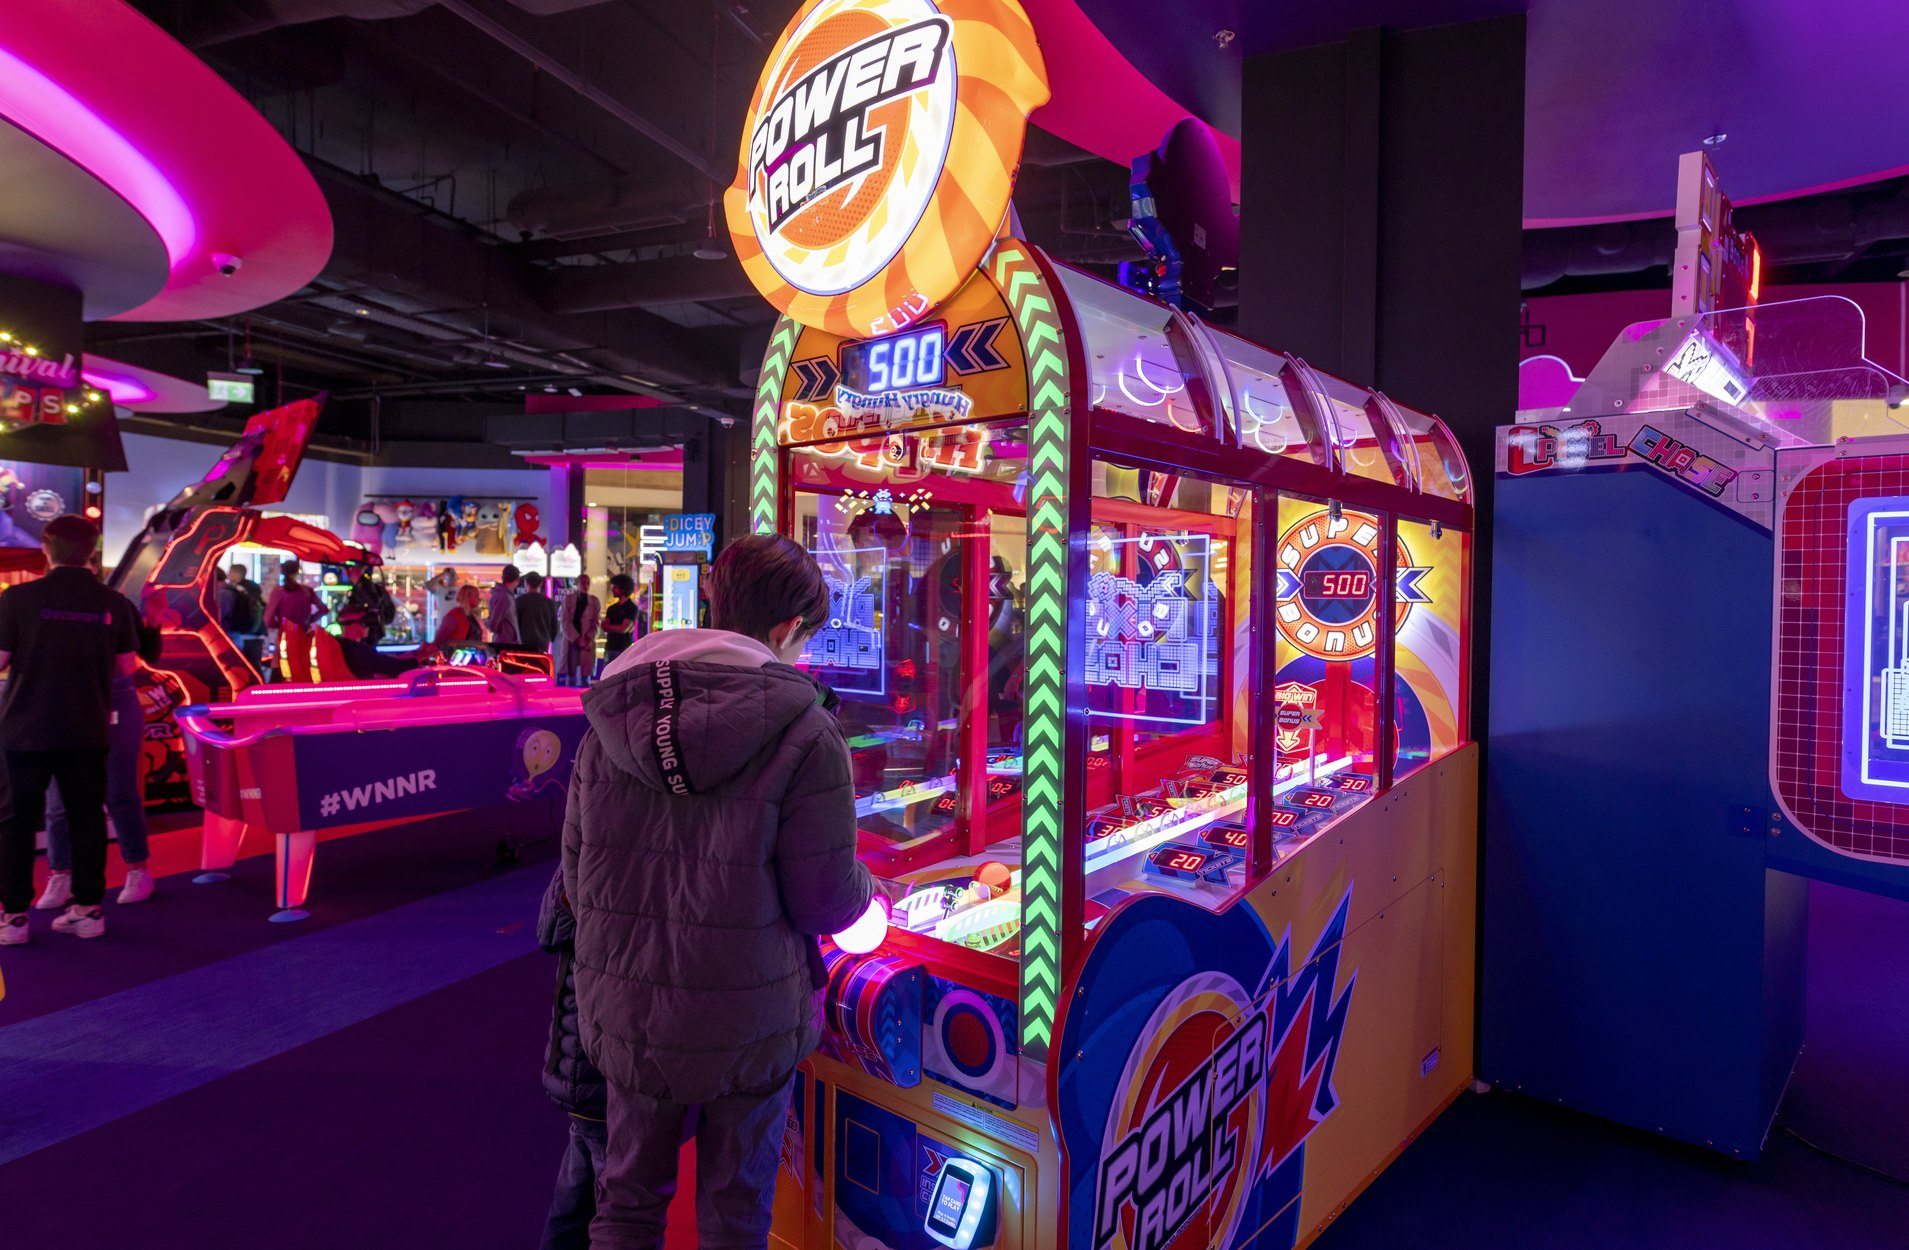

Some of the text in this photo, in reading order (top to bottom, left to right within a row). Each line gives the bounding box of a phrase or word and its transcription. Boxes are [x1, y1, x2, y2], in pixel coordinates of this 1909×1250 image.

[750, 26, 943, 193] POWER
[771, 116, 878, 223] ROLL
[868, 332, 941, 392] 500
[1631, 426, 1735, 495] CHASE
[669, 517, 712, 531] DICEY
[1281, 517, 1377, 570] SUPE
[1323, 574, 1367, 596] 500
[1277, 602, 1377, 653] BONU
[655, 658, 688, 795] SUPPLY YOUNG SU
[319, 768, 438, 818] #WNNR
[1305, 794, 1332, 807] 20
[1341, 779, 1366, 791] 30
[1170, 854, 1202, 870] 20
[1225, 832, 1247, 846] 40
[1101, 1026, 1263, 1237] POWER
[1137, 1124, 1236, 1250] ROLL
